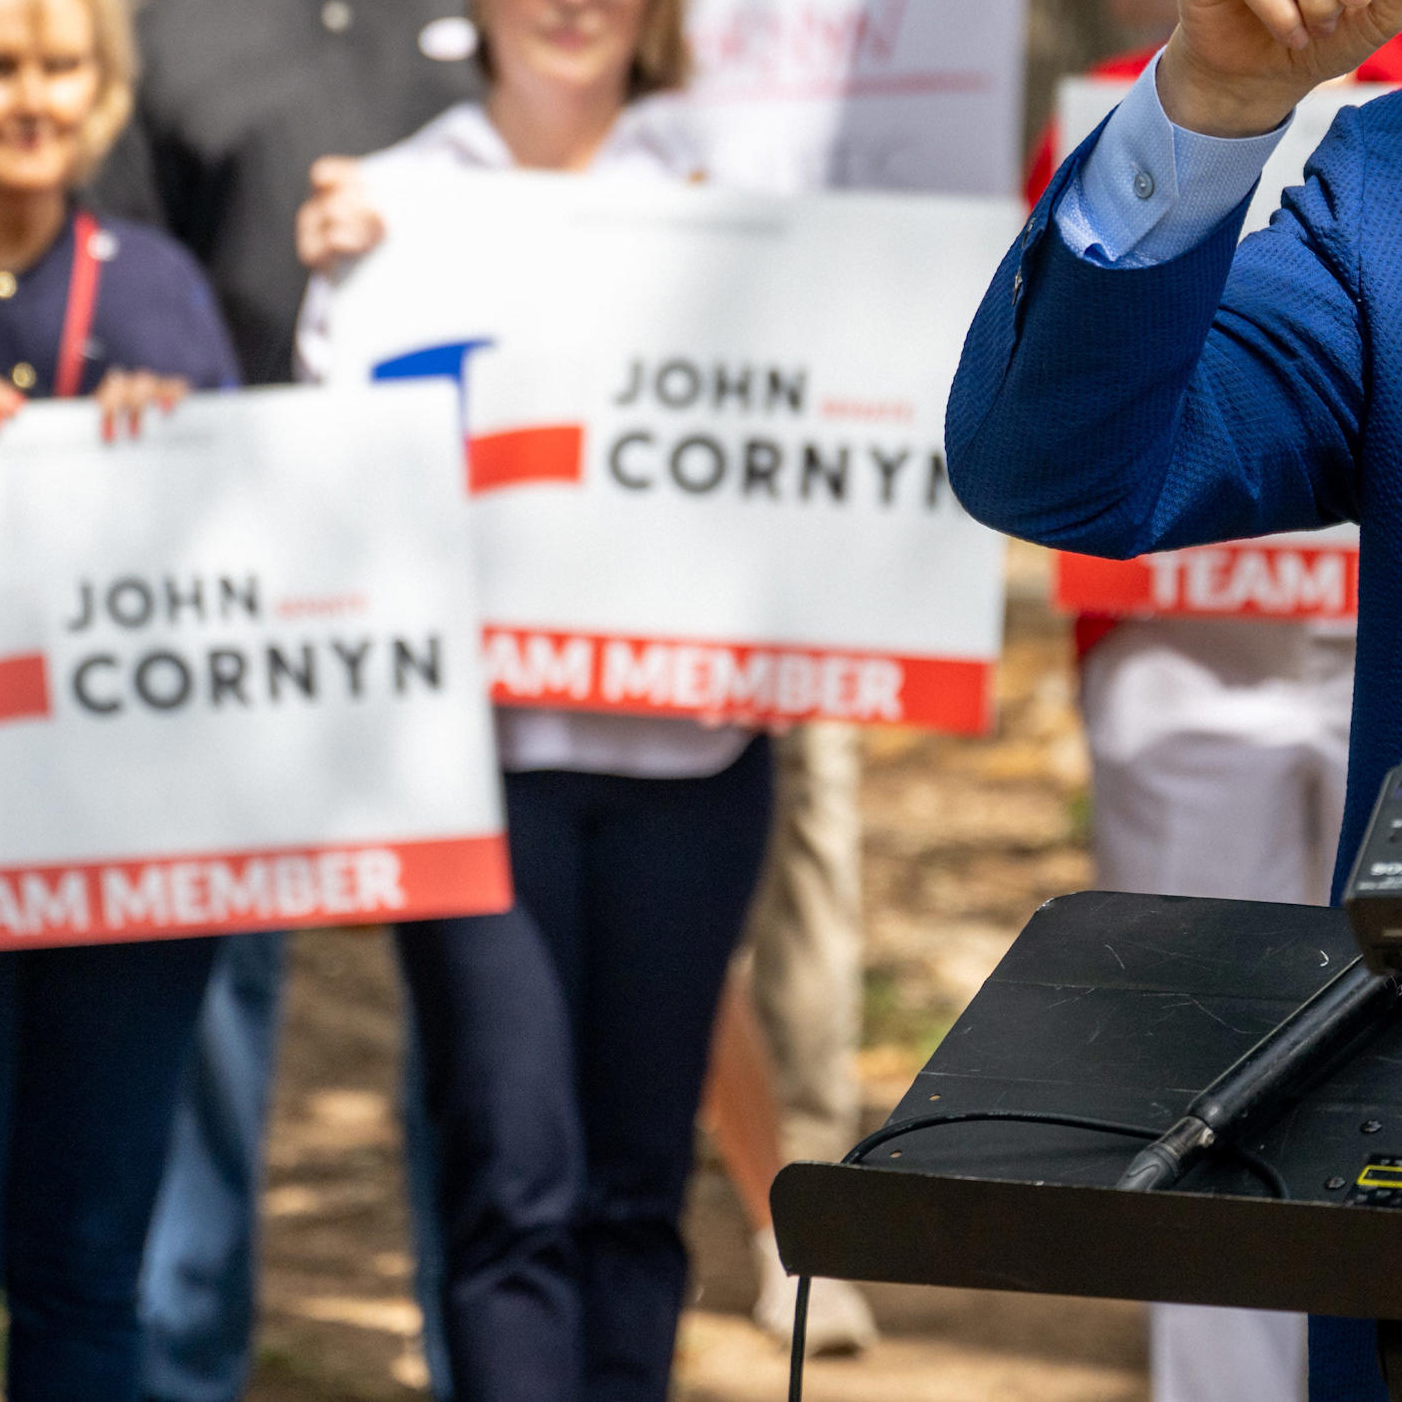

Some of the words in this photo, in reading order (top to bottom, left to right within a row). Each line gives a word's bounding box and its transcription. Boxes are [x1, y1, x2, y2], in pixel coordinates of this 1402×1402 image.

[614, 356, 810, 413] JOHN
[67, 573, 263, 633] JOHN
[1146, 551, 1345, 611] TEAM
[70, 635, 445, 716] CORNYN
[600, 642, 905, 721] MEMBER
[101, 847, 406, 929] MEMBER
